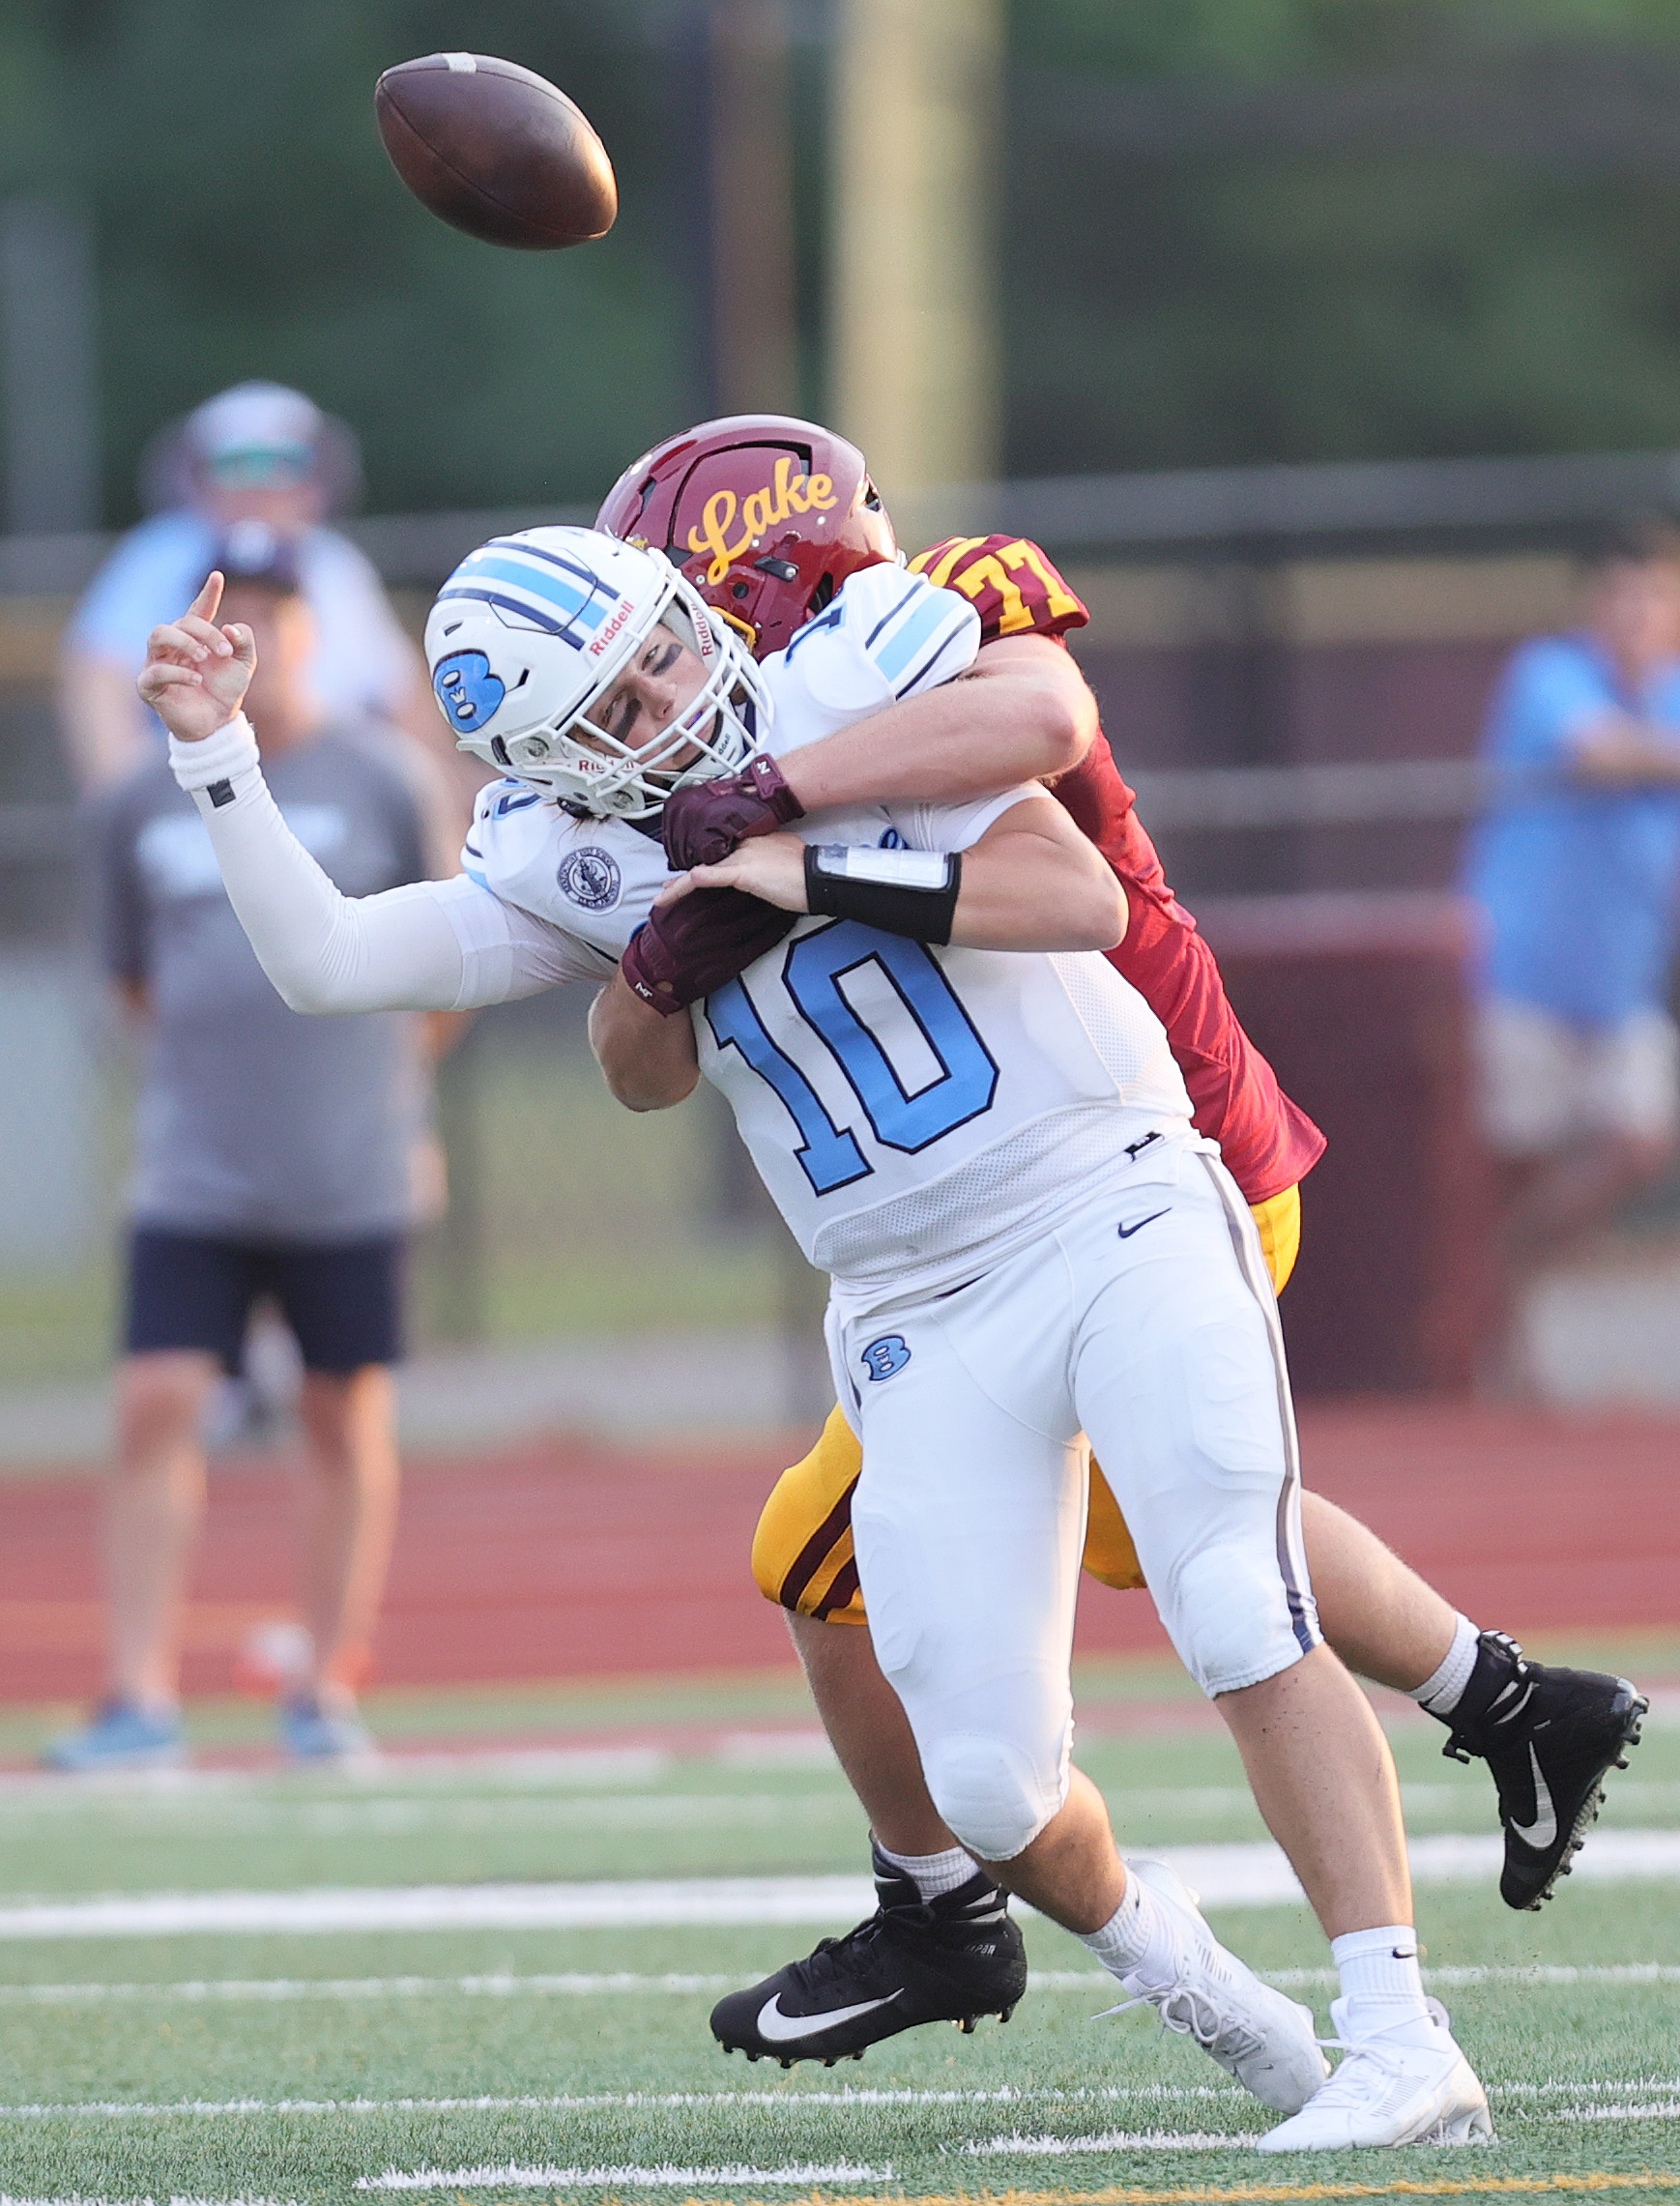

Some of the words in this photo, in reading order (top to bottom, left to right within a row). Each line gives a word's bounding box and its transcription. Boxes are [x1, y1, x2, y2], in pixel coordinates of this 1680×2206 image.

[687, 456, 839, 586] Lake
[589, 599, 635, 656] Riddell
[953, 538, 1080, 635] 77
[705, 916, 1000, 1198] 10
[860, 1334, 912, 1381] B
